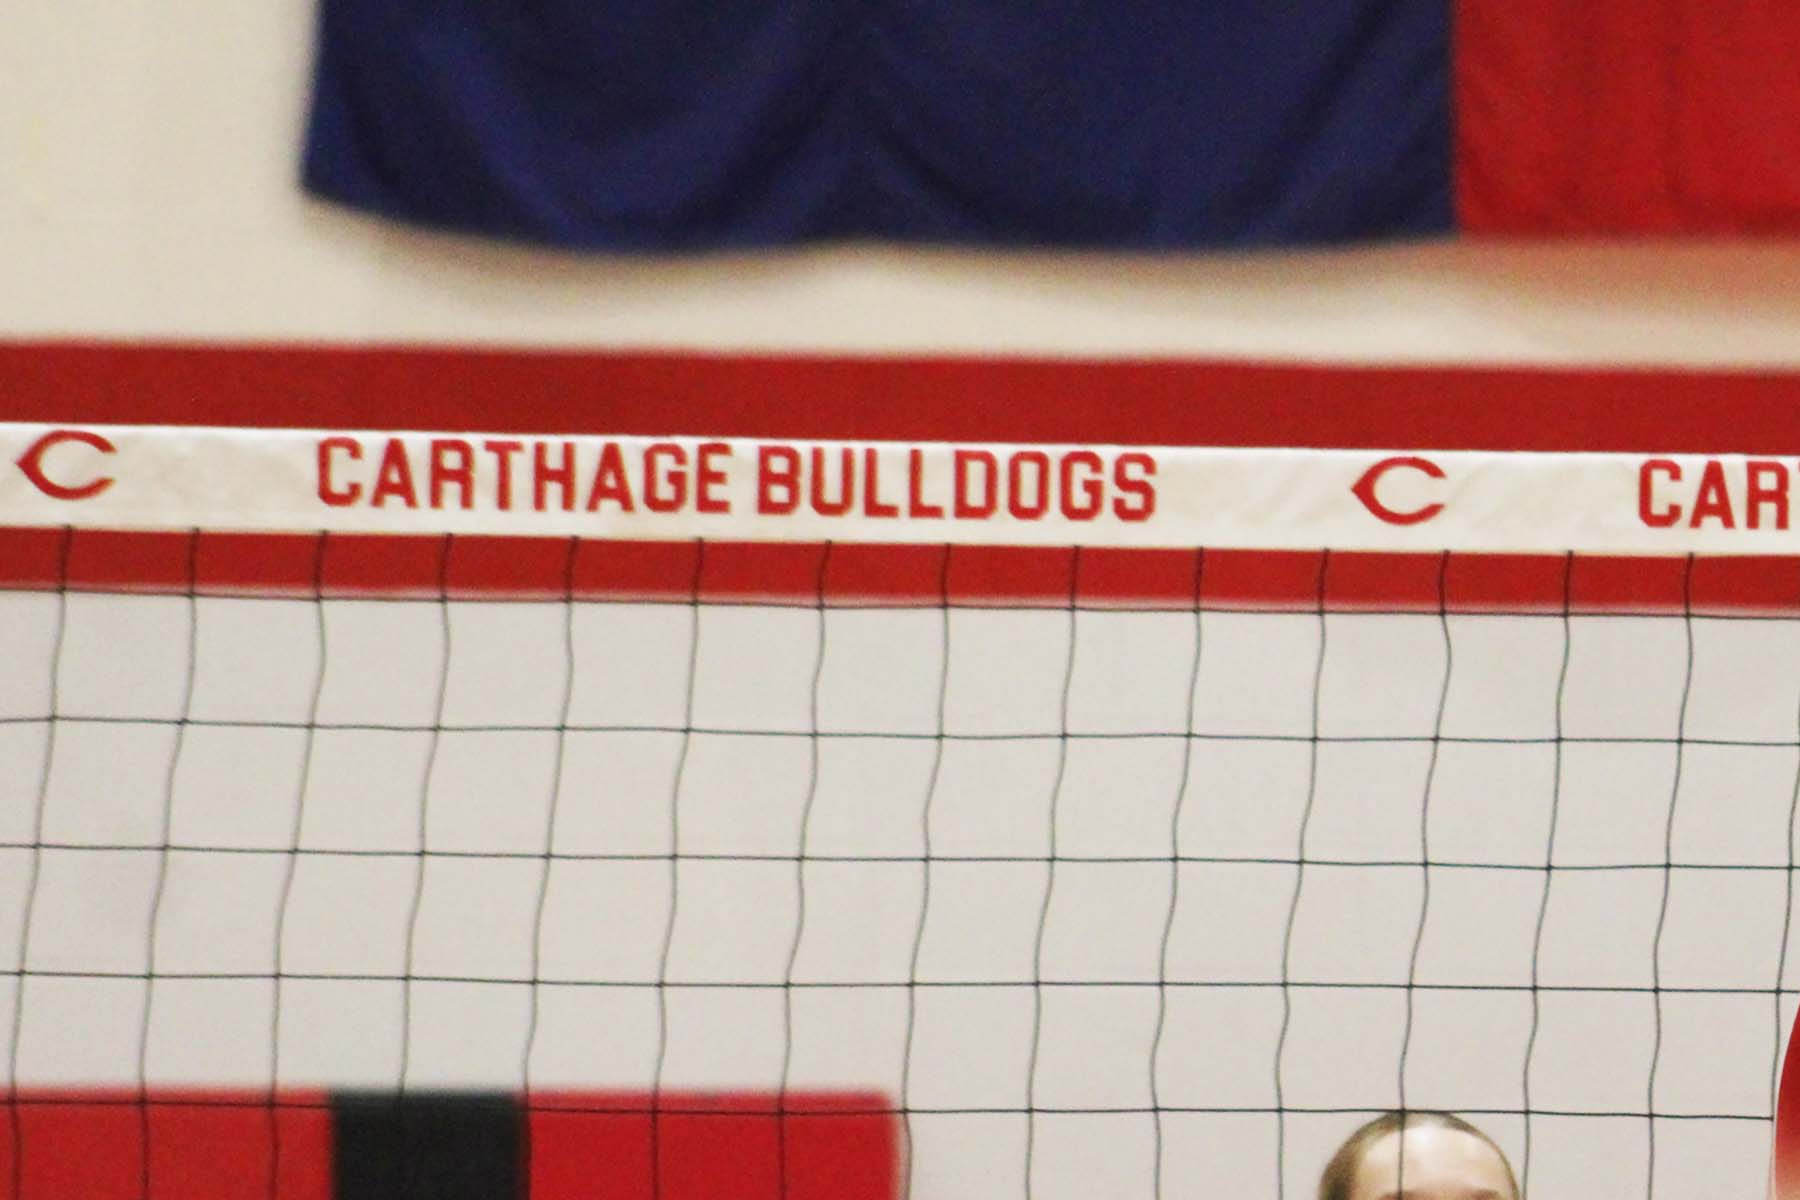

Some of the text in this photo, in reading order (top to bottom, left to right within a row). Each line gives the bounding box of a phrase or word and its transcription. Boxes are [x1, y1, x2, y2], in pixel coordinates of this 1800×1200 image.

[16, 429, 115, 499] C
[317, 437, 1158, 522] CARTHAGE BULLDOGS
[1351, 456, 1446, 526] C
